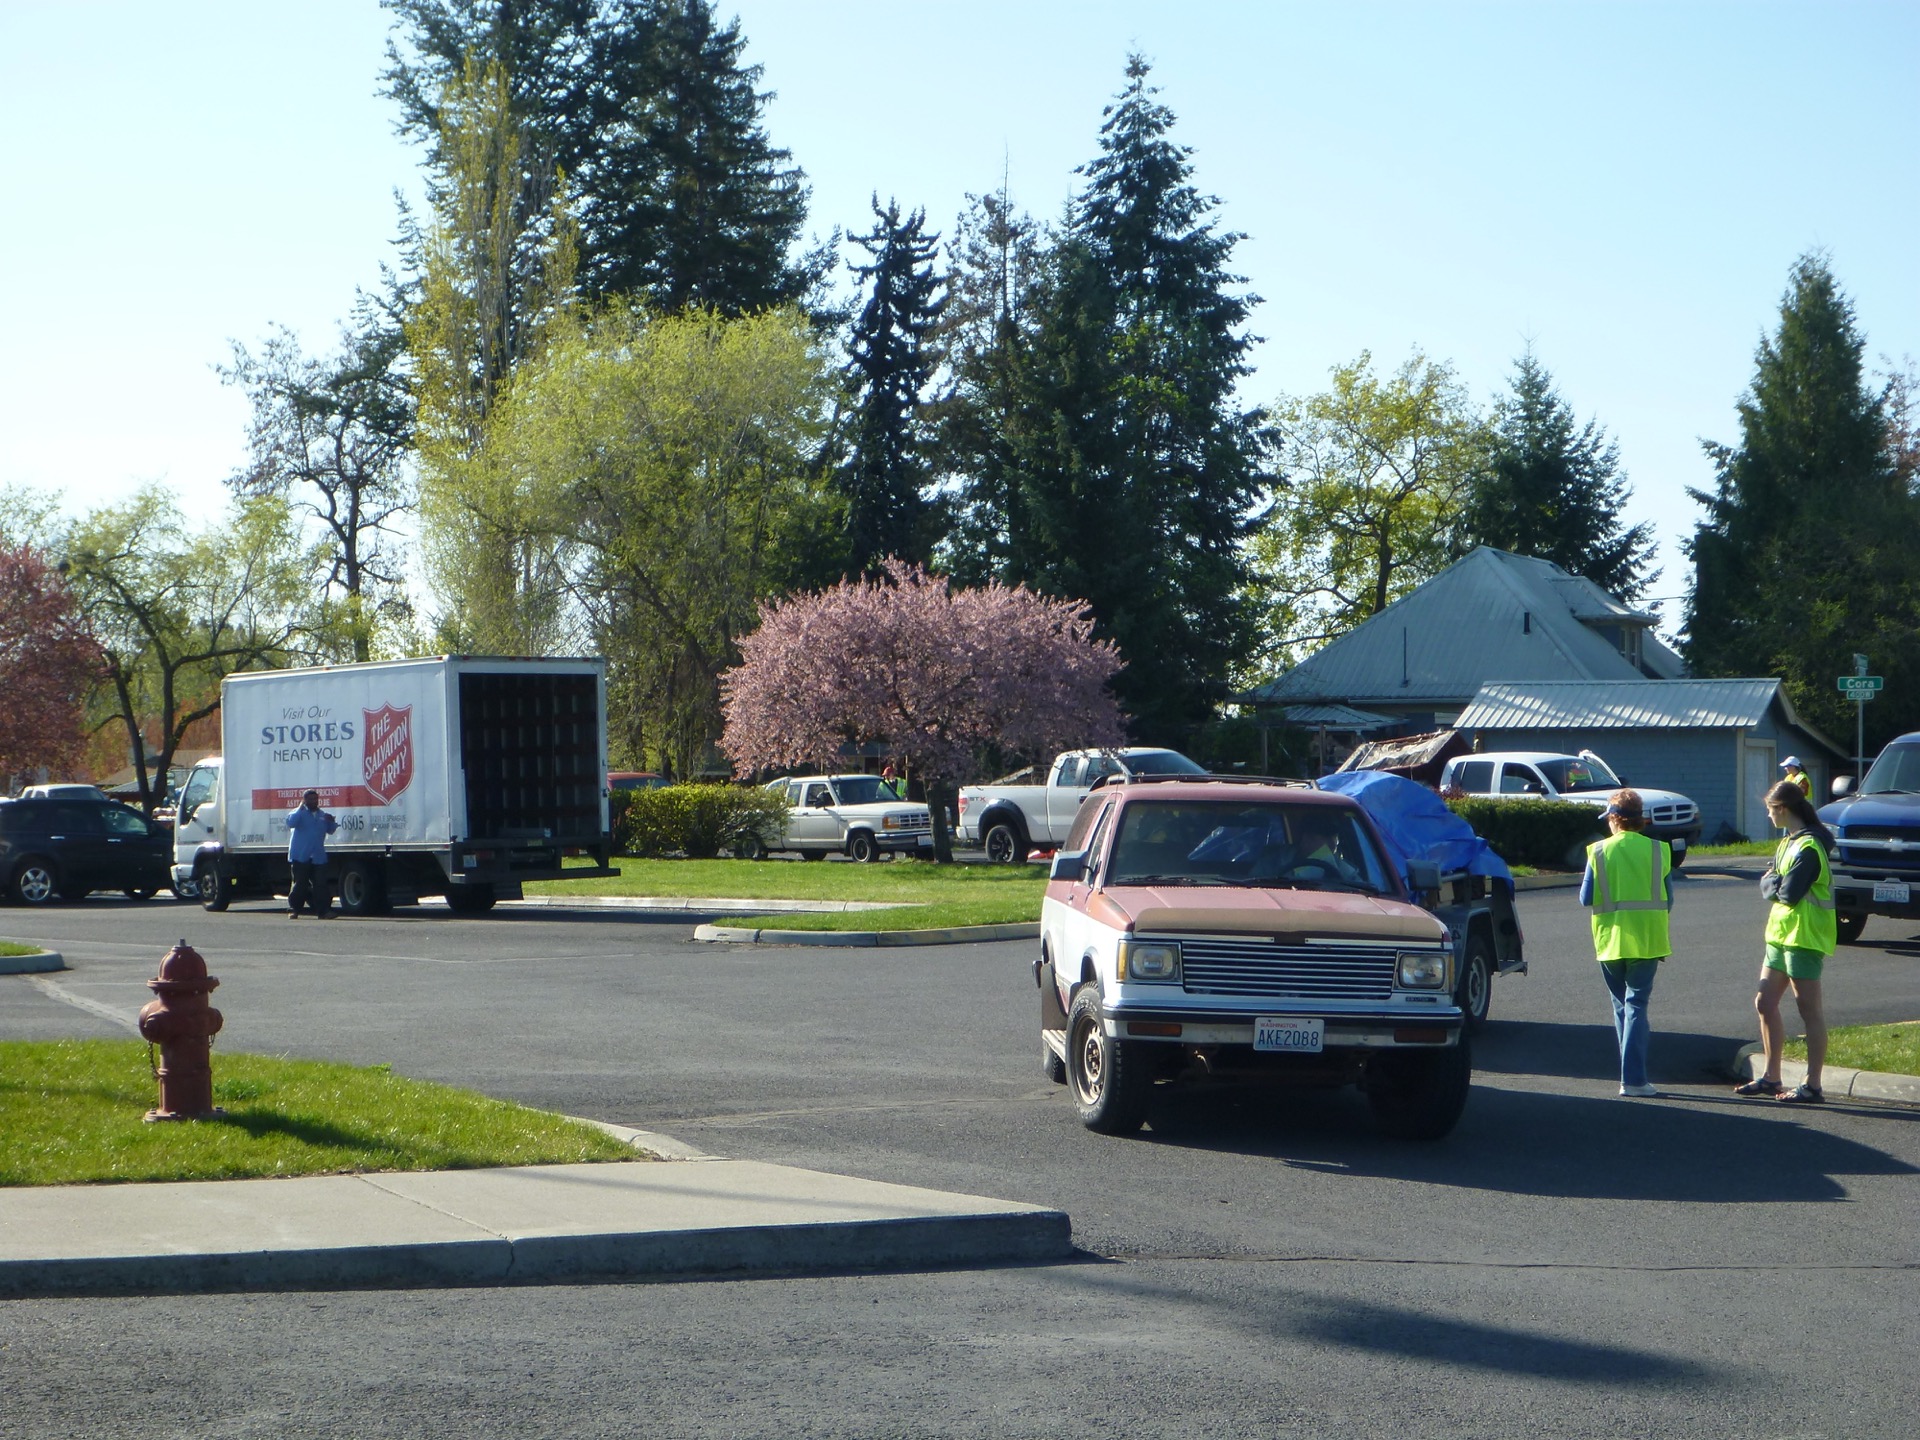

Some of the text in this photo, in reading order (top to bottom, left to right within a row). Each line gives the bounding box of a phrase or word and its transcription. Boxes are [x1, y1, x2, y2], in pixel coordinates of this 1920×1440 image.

[1847, 678, 1875, 689] Cora
[282, 705, 331, 720] Visit Our
[261, 721, 355, 745] STORES
[371, 712, 391, 746] THE
[273, 746, 343, 762] NEAR YOU
[365, 716, 407, 780] SALVATION
[380, 745, 407, 792] ARMY
[277, 789, 298, 798] THRIFT
[1258, 1029, 1319, 1047] AKE2088
